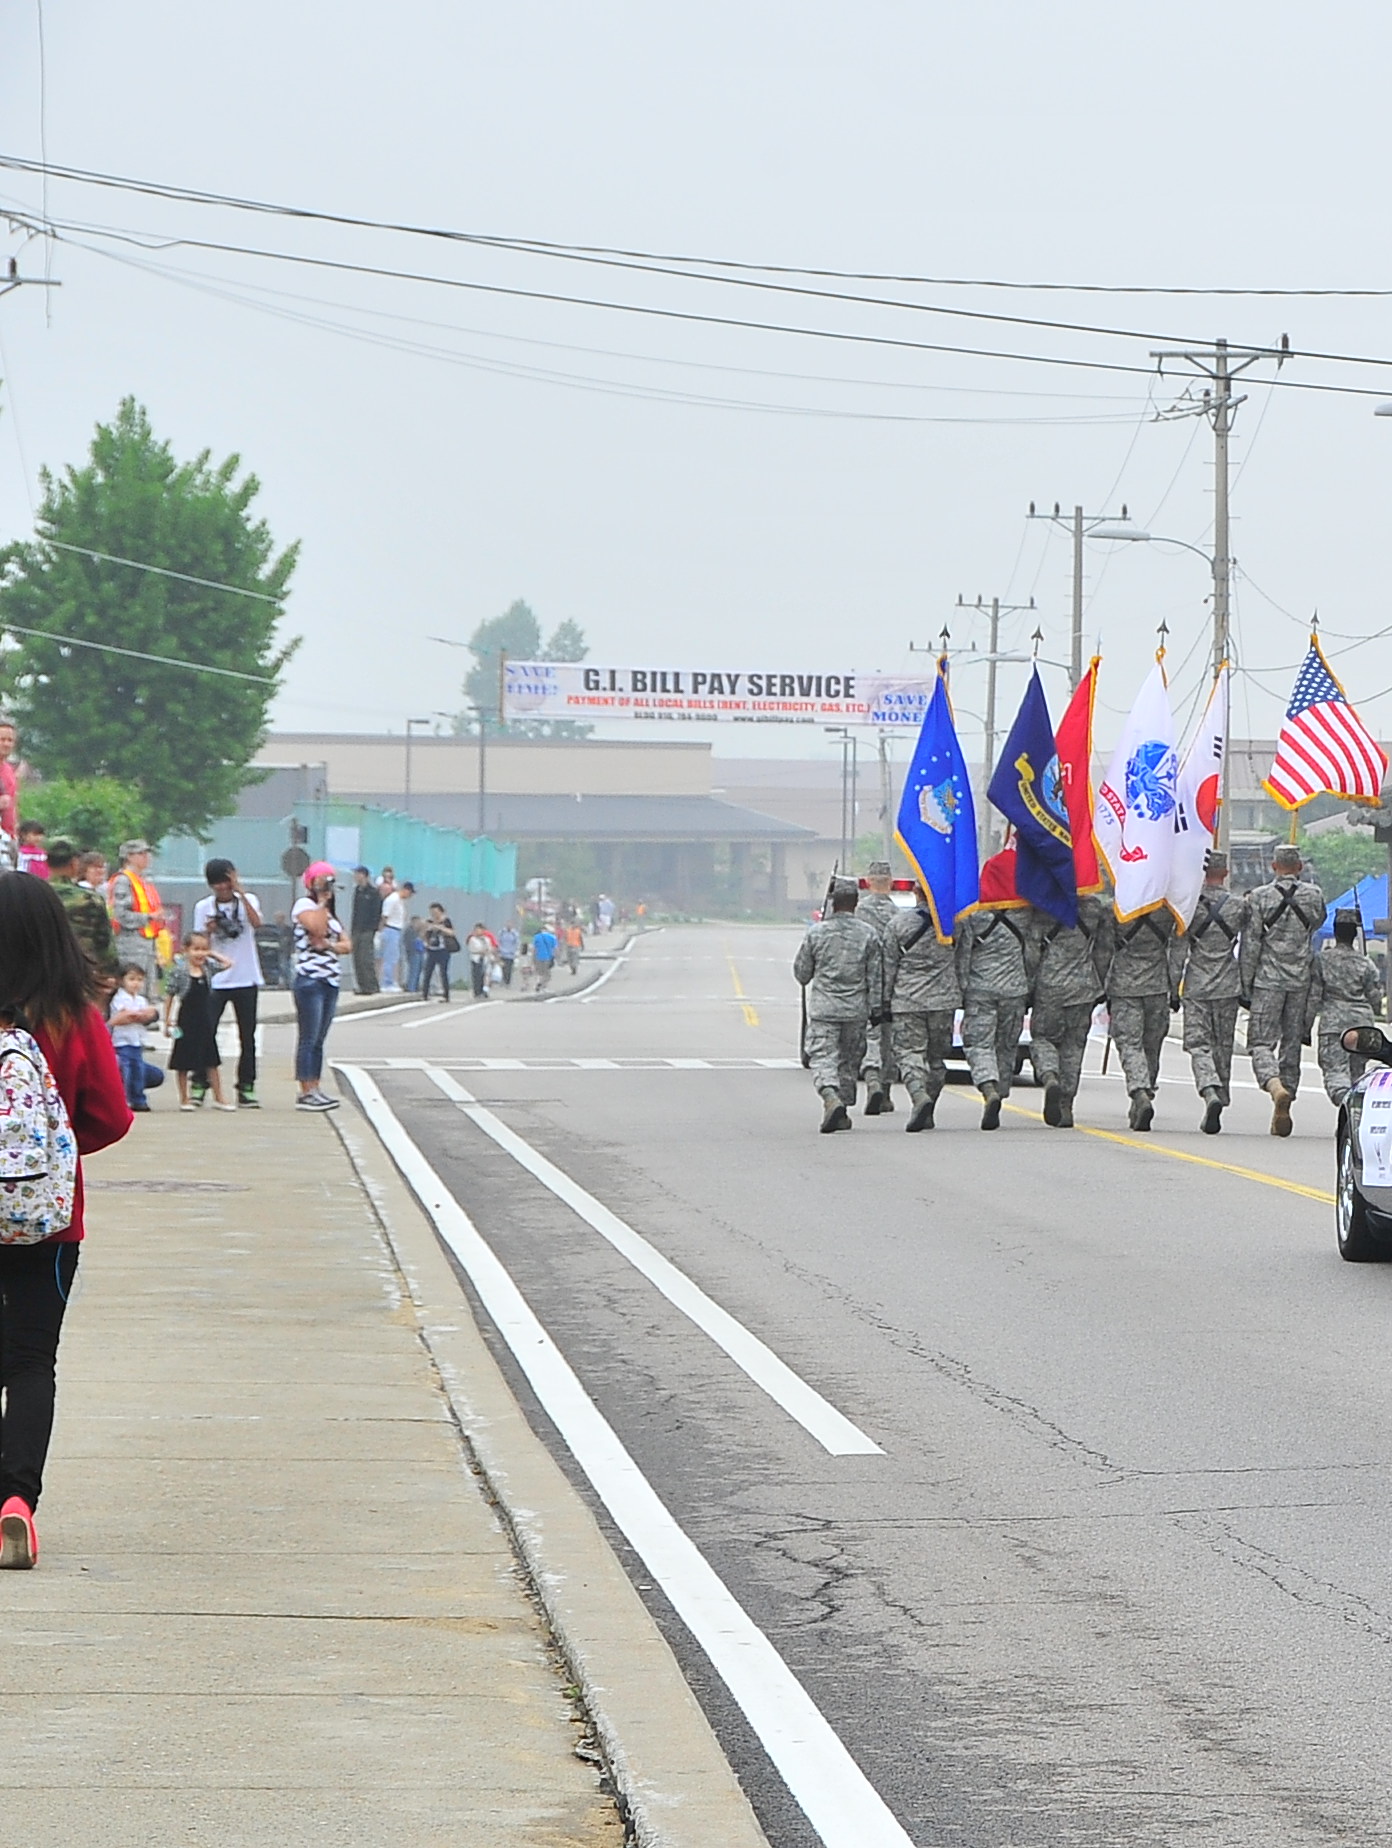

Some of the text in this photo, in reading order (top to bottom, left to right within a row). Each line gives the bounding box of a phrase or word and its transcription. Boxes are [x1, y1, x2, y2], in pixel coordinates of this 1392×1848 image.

[584, 668, 855, 698] G.I. BILL PAY SERVICE
[567, 695, 615, 706] PAYMENT
[618, 697, 630, 706] OF
[634, 698, 650, 707] ALL
[653, 698, 684, 708] LOCAL
[687, 699, 714, 709] BILLS
[883, 694, 928, 706] SAVE
[872, 711, 923, 722] MONE
